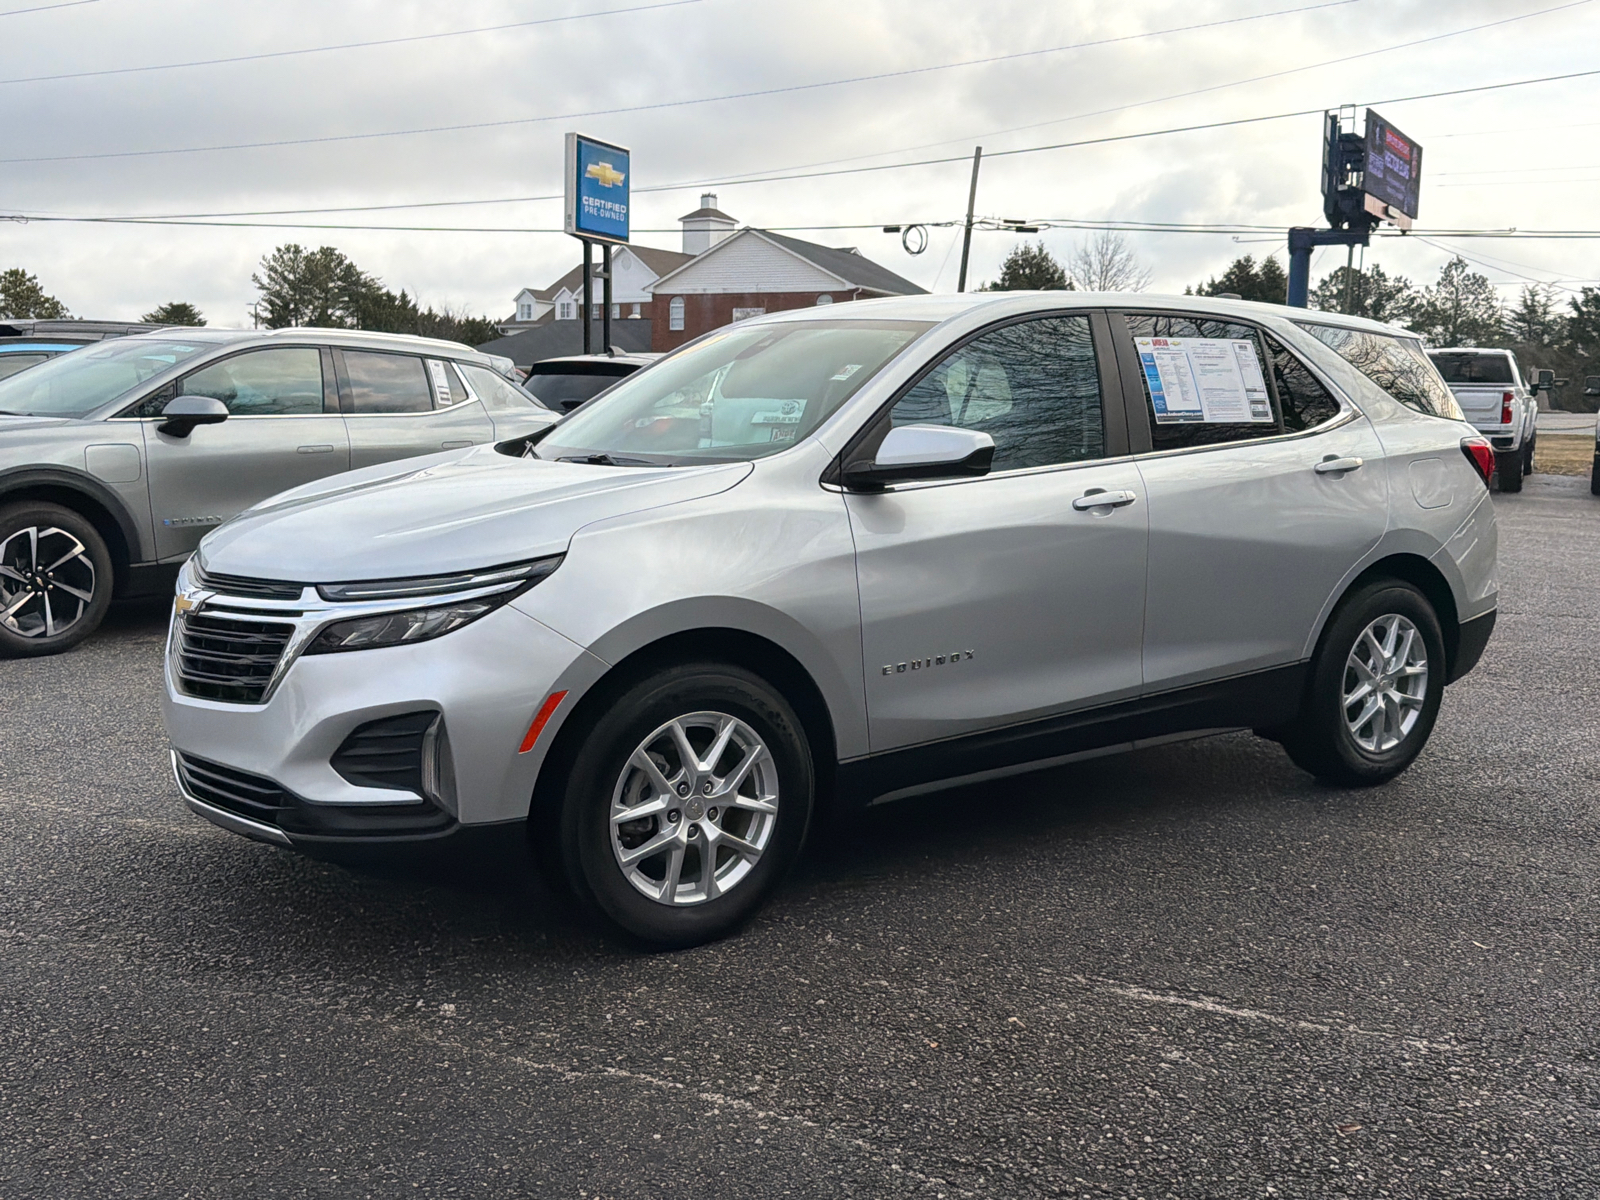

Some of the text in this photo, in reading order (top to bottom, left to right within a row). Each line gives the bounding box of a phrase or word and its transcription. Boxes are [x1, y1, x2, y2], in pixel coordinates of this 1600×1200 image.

[582, 196, 627, 213] CERTIFIED
[584, 205, 625, 222] PRE-OWNED
[882, 649, 975, 676] EQUINOX
